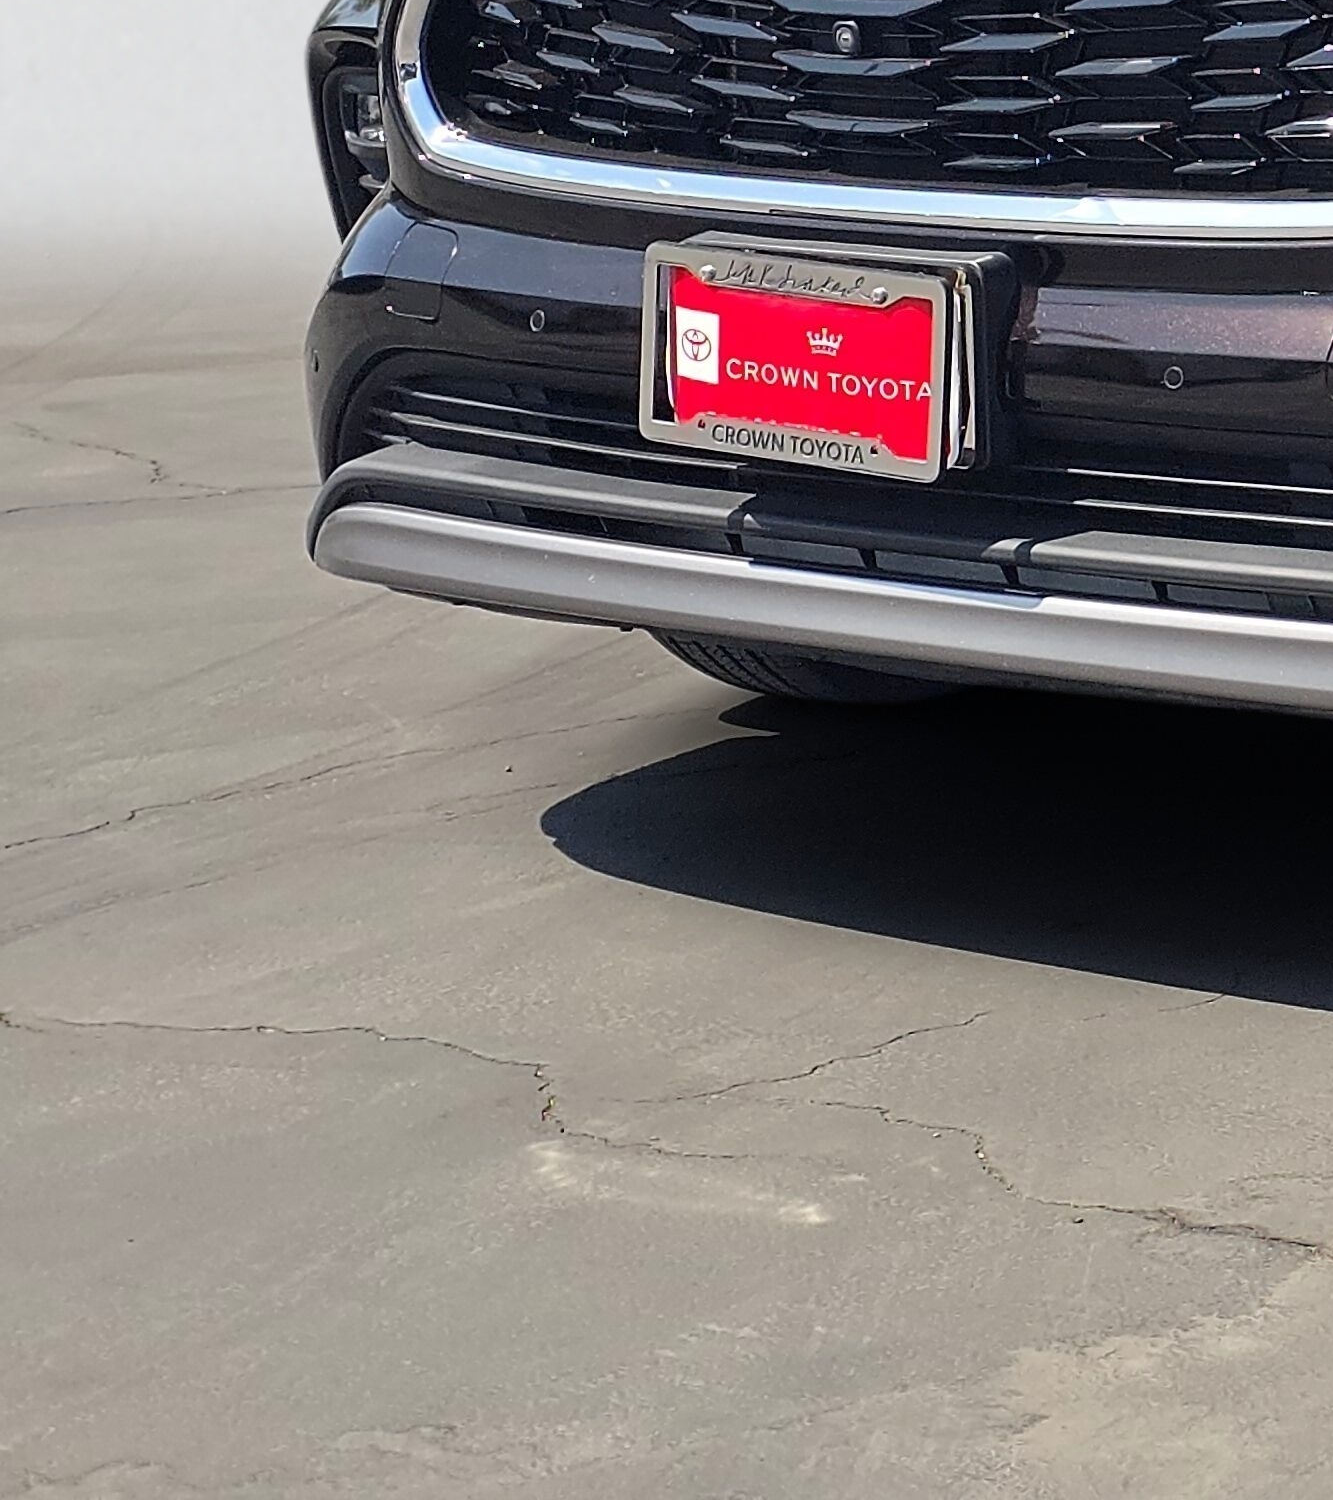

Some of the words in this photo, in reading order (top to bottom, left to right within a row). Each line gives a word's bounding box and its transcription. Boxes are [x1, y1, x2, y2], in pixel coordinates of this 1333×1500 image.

[725, 358, 819, 390] CROWN
[827, 372, 931, 401] TOYOTA
[712, 424, 784, 452] CROWN
[790, 435, 864, 464] TOYOTA
